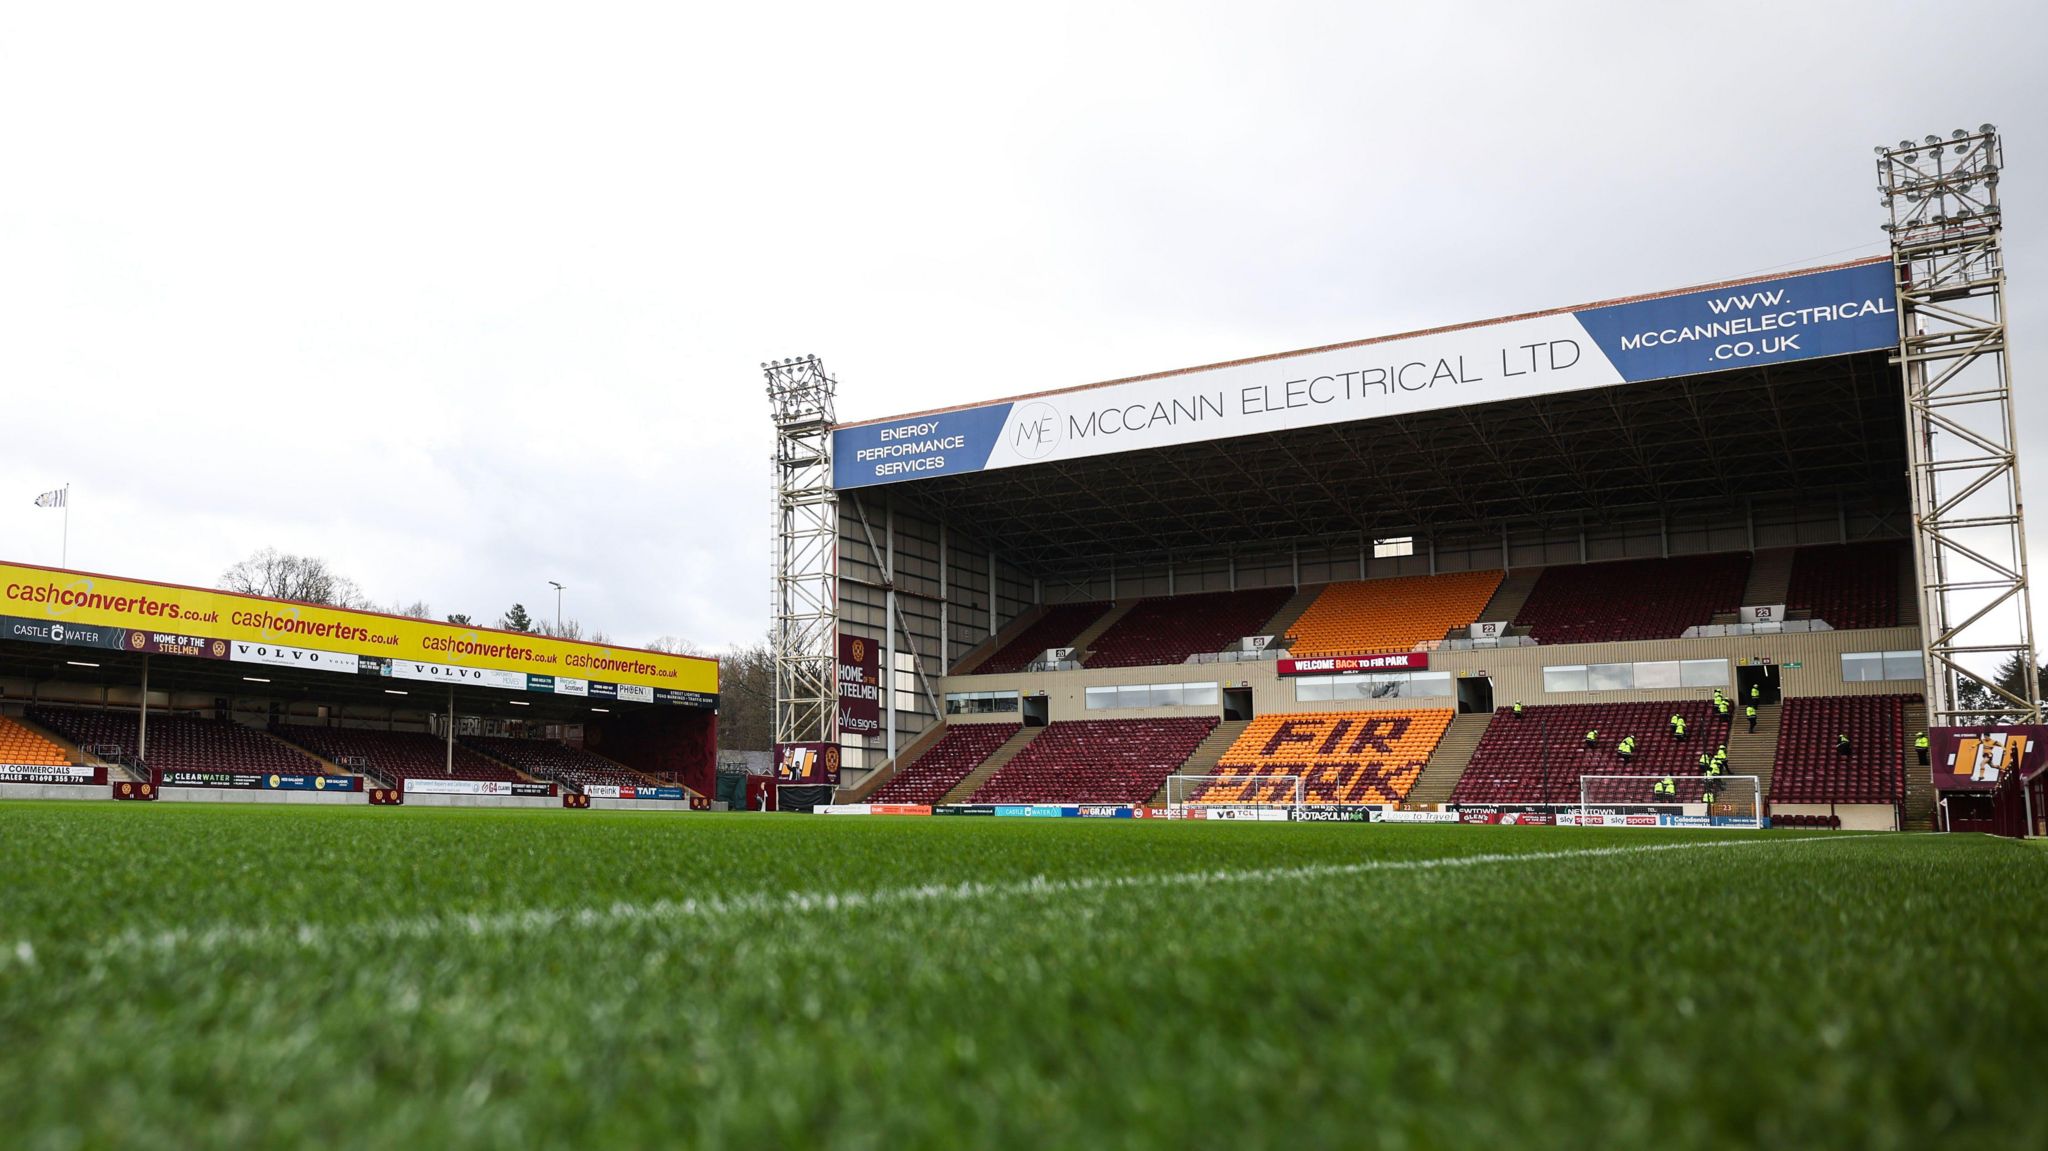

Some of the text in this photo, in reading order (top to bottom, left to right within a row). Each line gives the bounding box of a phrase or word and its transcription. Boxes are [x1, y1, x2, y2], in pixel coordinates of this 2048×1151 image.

[1707, 289, 1791, 315] WWW.
[1620, 298, 1895, 351] MCCANNELECTRICAL
[1709, 334, 1800, 361] .CO.UK
[1069, 339, 1580, 440] MCCANN ELECTRICAL LTD
[881, 421, 939, 441] ENERGY
[857, 435, 965, 462] PERFORMANCE
[875, 456, 945, 477] SERVICES
[6, 583, 219, 623] cashconverters.co.uk
[14, 625, 99, 642] CASTLE WATER
[232, 610, 399, 646] cashconverters.co.uk
[153, 633, 205, 647] HOME OF THE
[159, 644, 198, 655] STEELMEN
[422, 636, 557, 664] cashconverters.co.uk
[565, 653, 678, 678] cashconverters.co.uk
[1295, 655, 1408, 671] WELCOME BACK TO FIR PARK
[838, 664, 863, 683] HOME
[838, 682, 878, 700] STEELMEN
[1259, 716, 1414, 758] FIR
[0, 773, 23, 781] SALES
[9, 765, 70, 775] COMMERCIALS
[175, 773, 230, 781] CLEARWATER
[637, 787, 657, 795] TAIT
[1426, 812, 1454, 820] Travel
[1559, 816, 1574, 824] sky
[1611, 816, 1655, 825] sky sports
